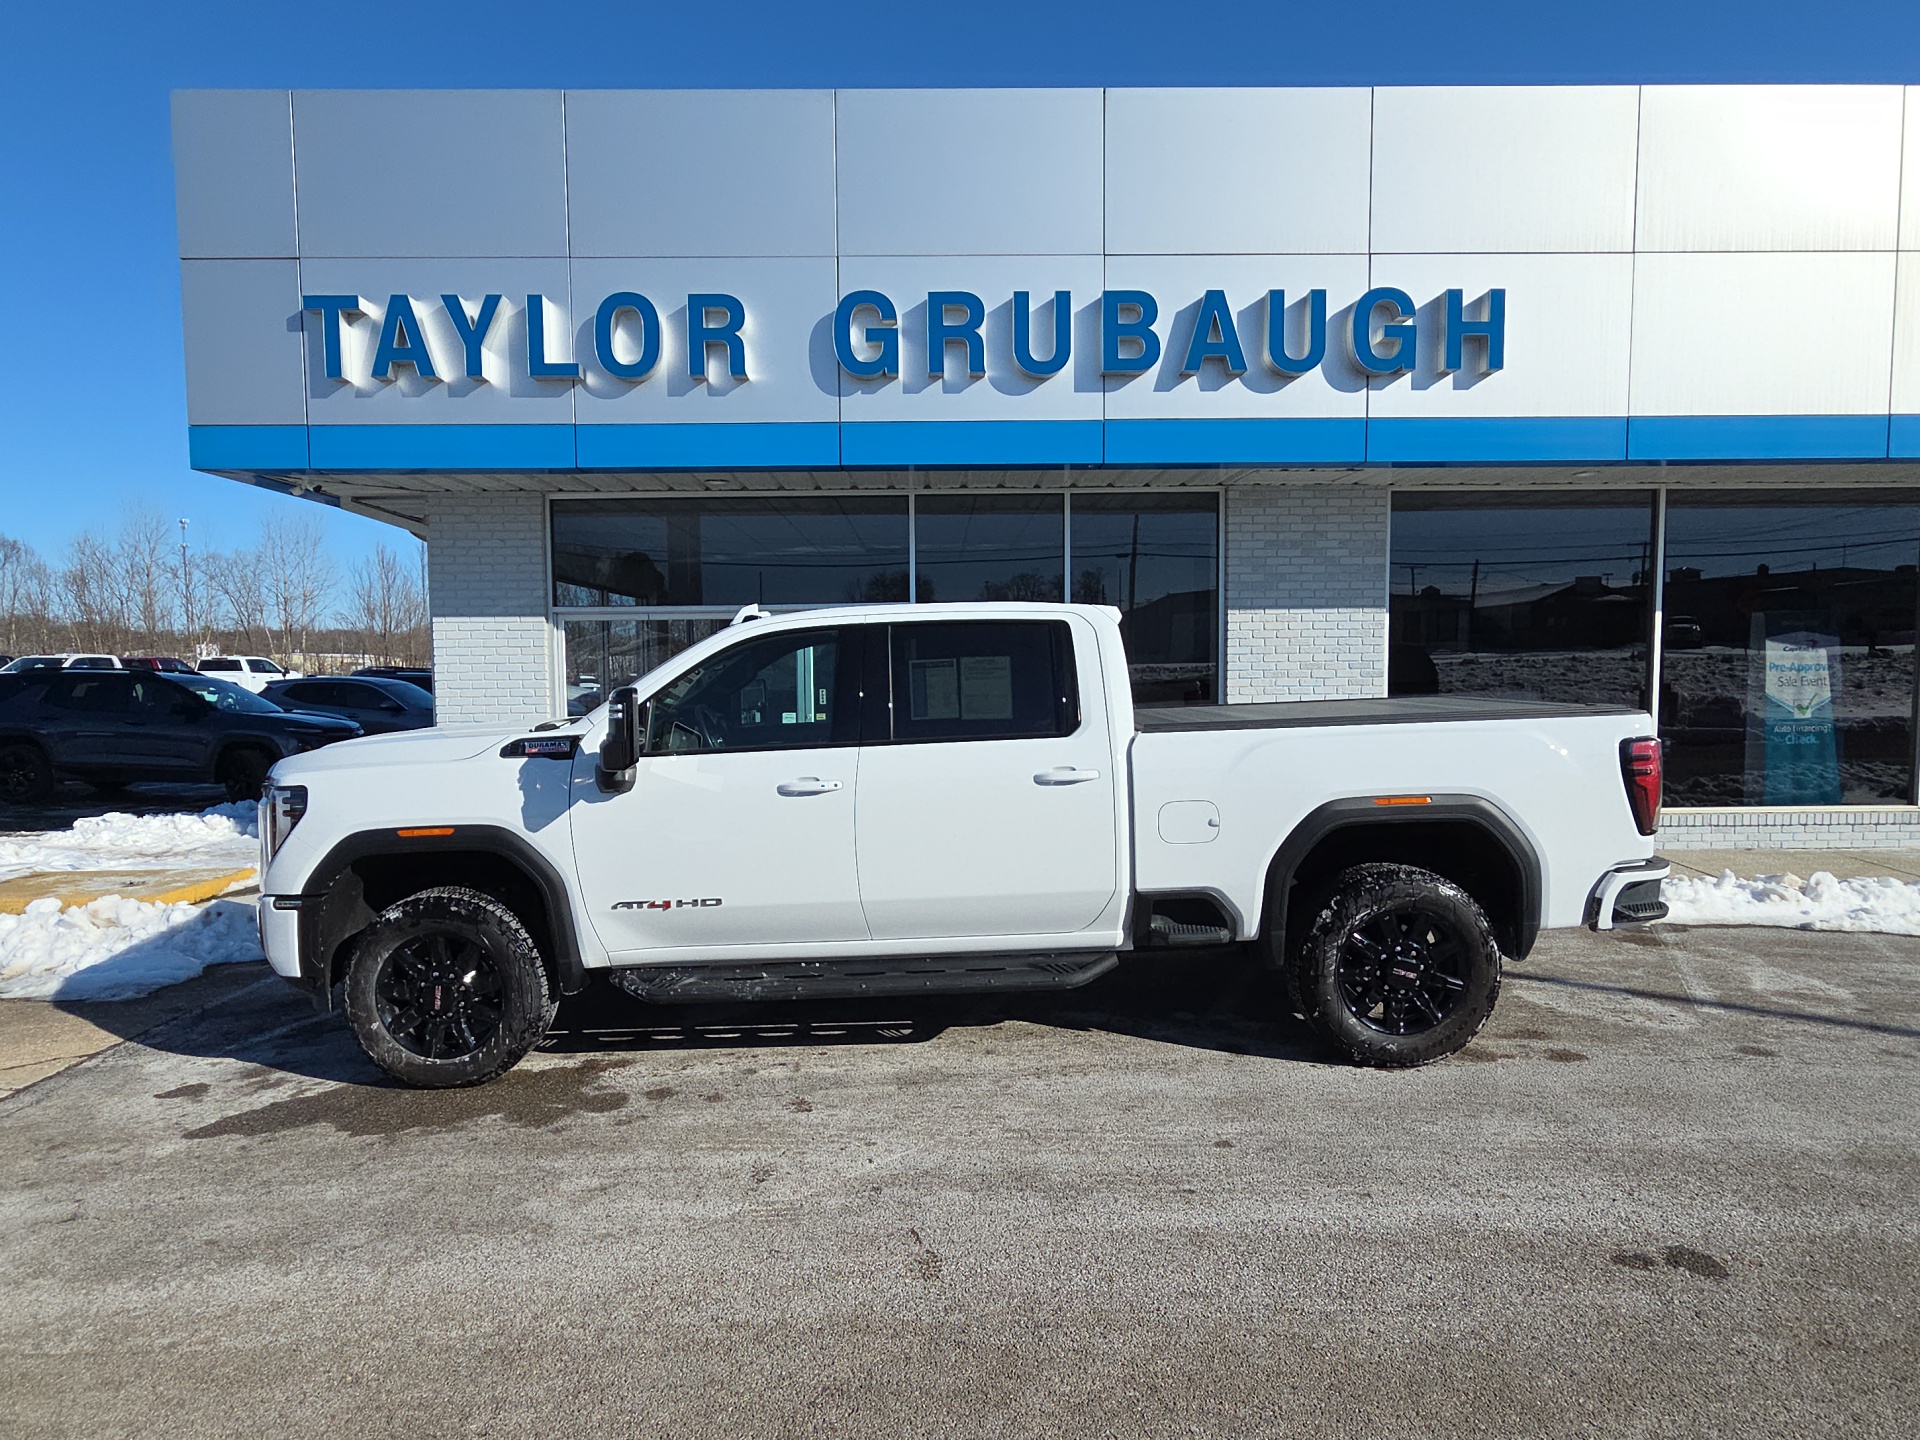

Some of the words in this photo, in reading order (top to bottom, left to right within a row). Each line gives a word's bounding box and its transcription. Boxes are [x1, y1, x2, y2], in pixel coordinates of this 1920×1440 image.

[302, 291, 749, 382] TAYLOR
[832, 287, 1506, 379] GRUBAUGH
[1777, 675, 1798, 687] Sale
[1800, 675, 1828, 687] Event
[528, 741, 568, 749] DURAMAX
